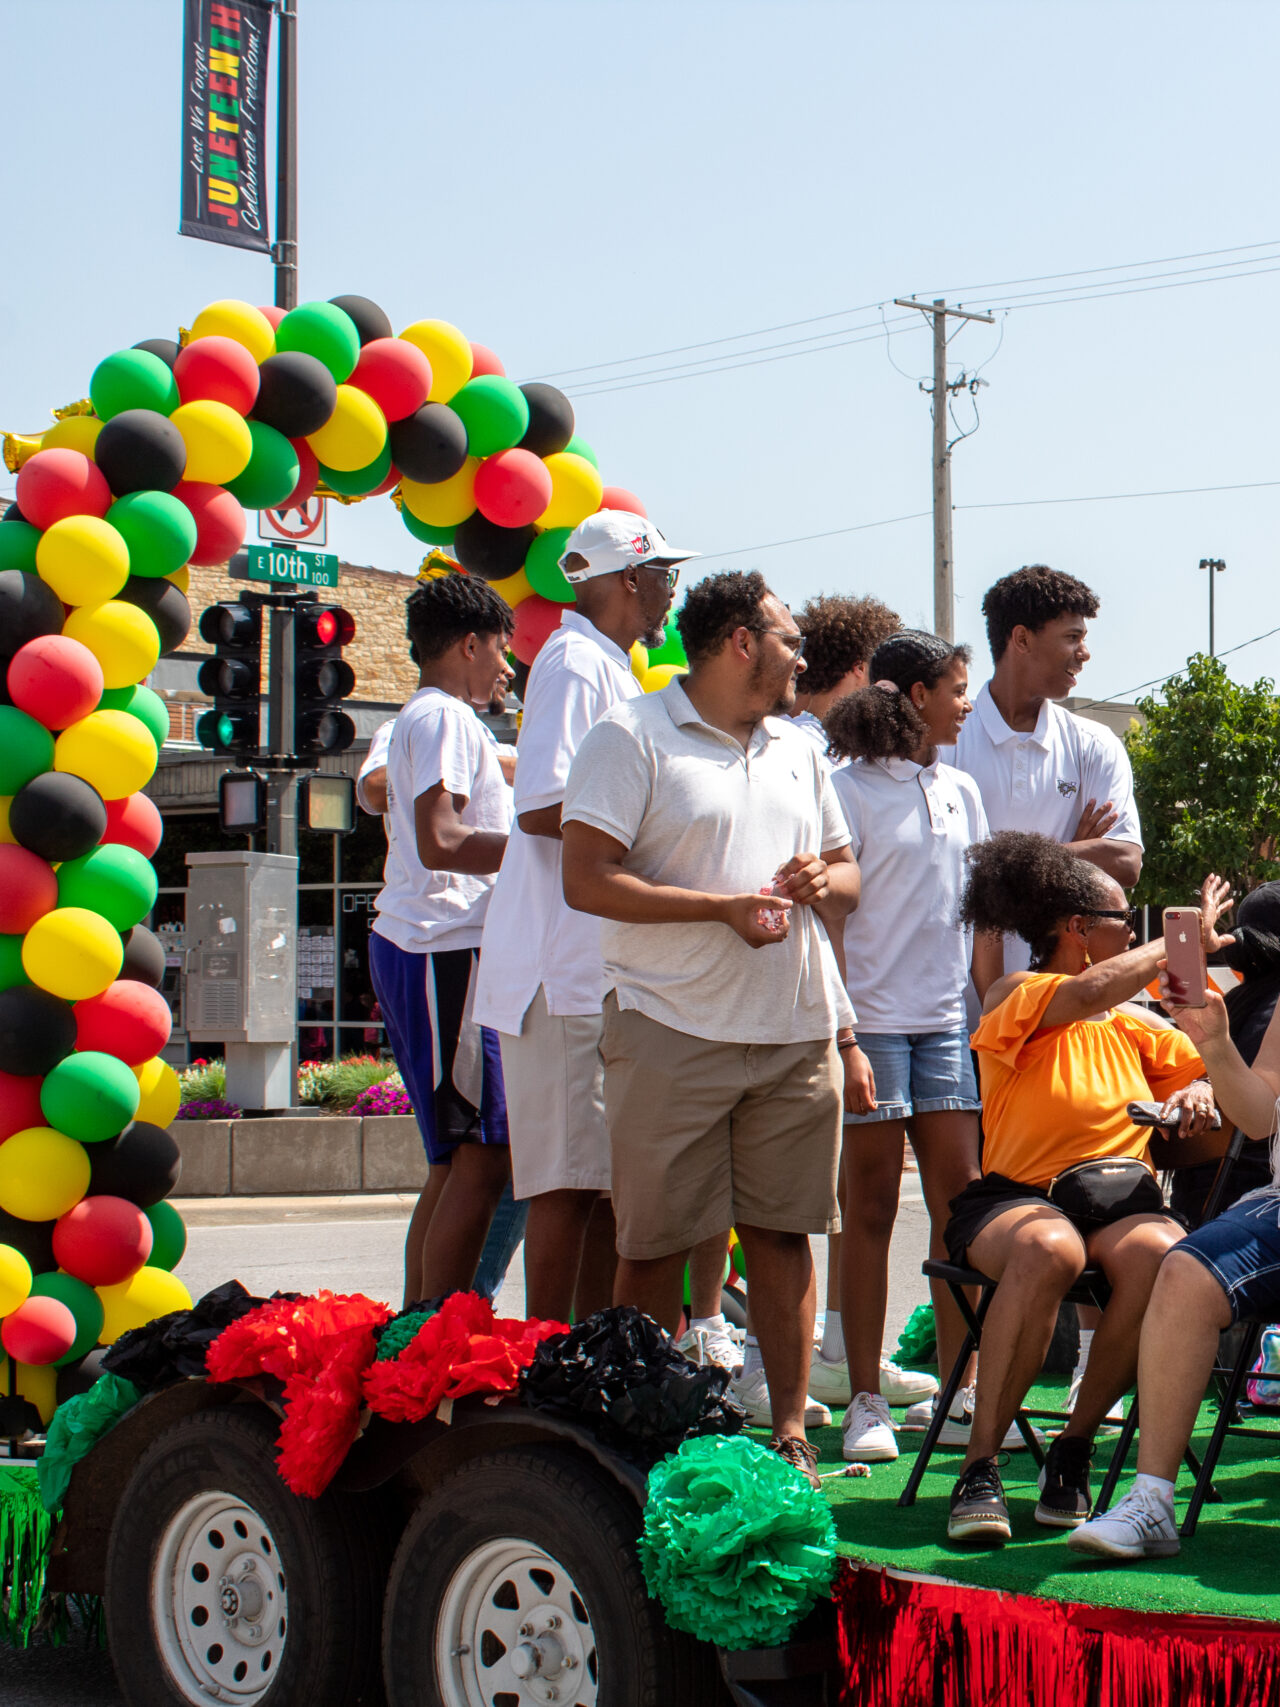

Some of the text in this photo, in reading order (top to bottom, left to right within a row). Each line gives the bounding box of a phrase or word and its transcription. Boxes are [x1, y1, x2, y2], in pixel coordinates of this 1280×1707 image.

[190, 42, 209, 174] Lest We Forget
[208, 2, 241, 228] JUNETEENTH
[239, 16, 262, 231] Celebrate Freedom!
[257, 552, 308, 580] E 10th
[314, 555, 327, 567] ST
[311, 572, 330, 585] 100
[343, 894, 381, 912] OPE
